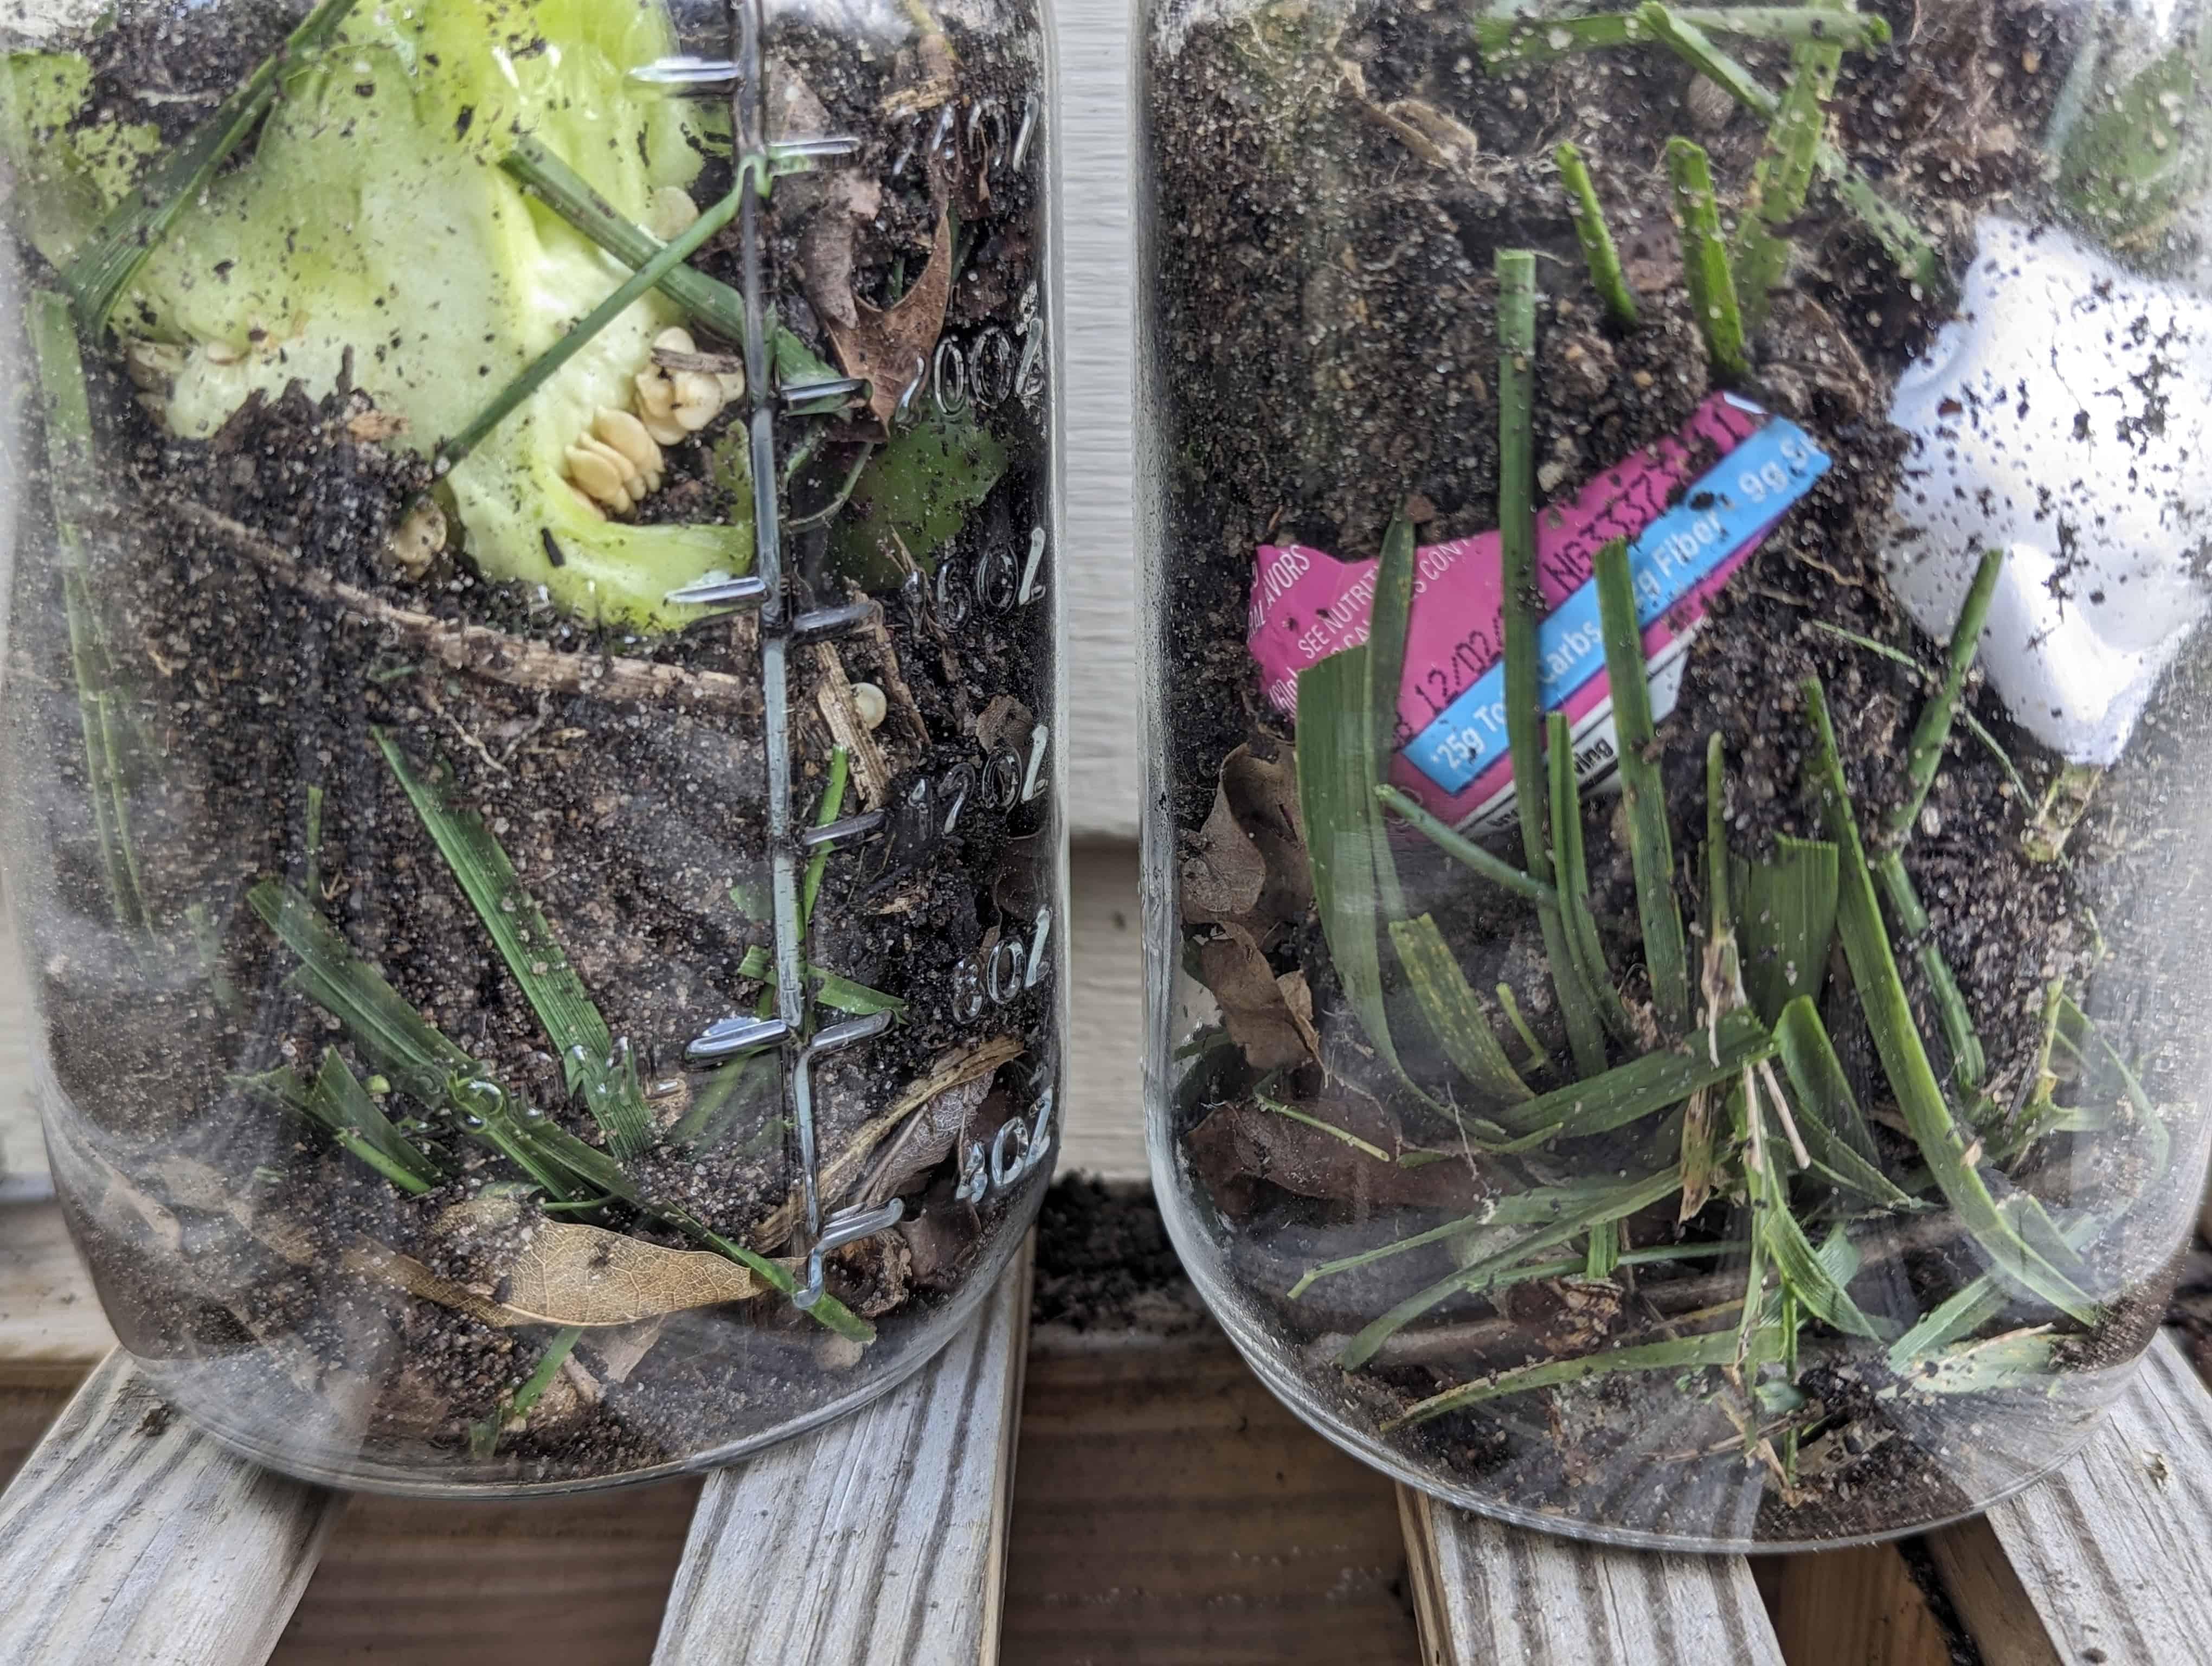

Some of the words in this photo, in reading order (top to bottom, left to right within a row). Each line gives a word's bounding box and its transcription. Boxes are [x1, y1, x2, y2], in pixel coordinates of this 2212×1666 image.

[1652, 510, 1721, 578] Fiber
[1738, 461, 1788, 503] 9g
[1298, 625, 1330, 659] SEE
